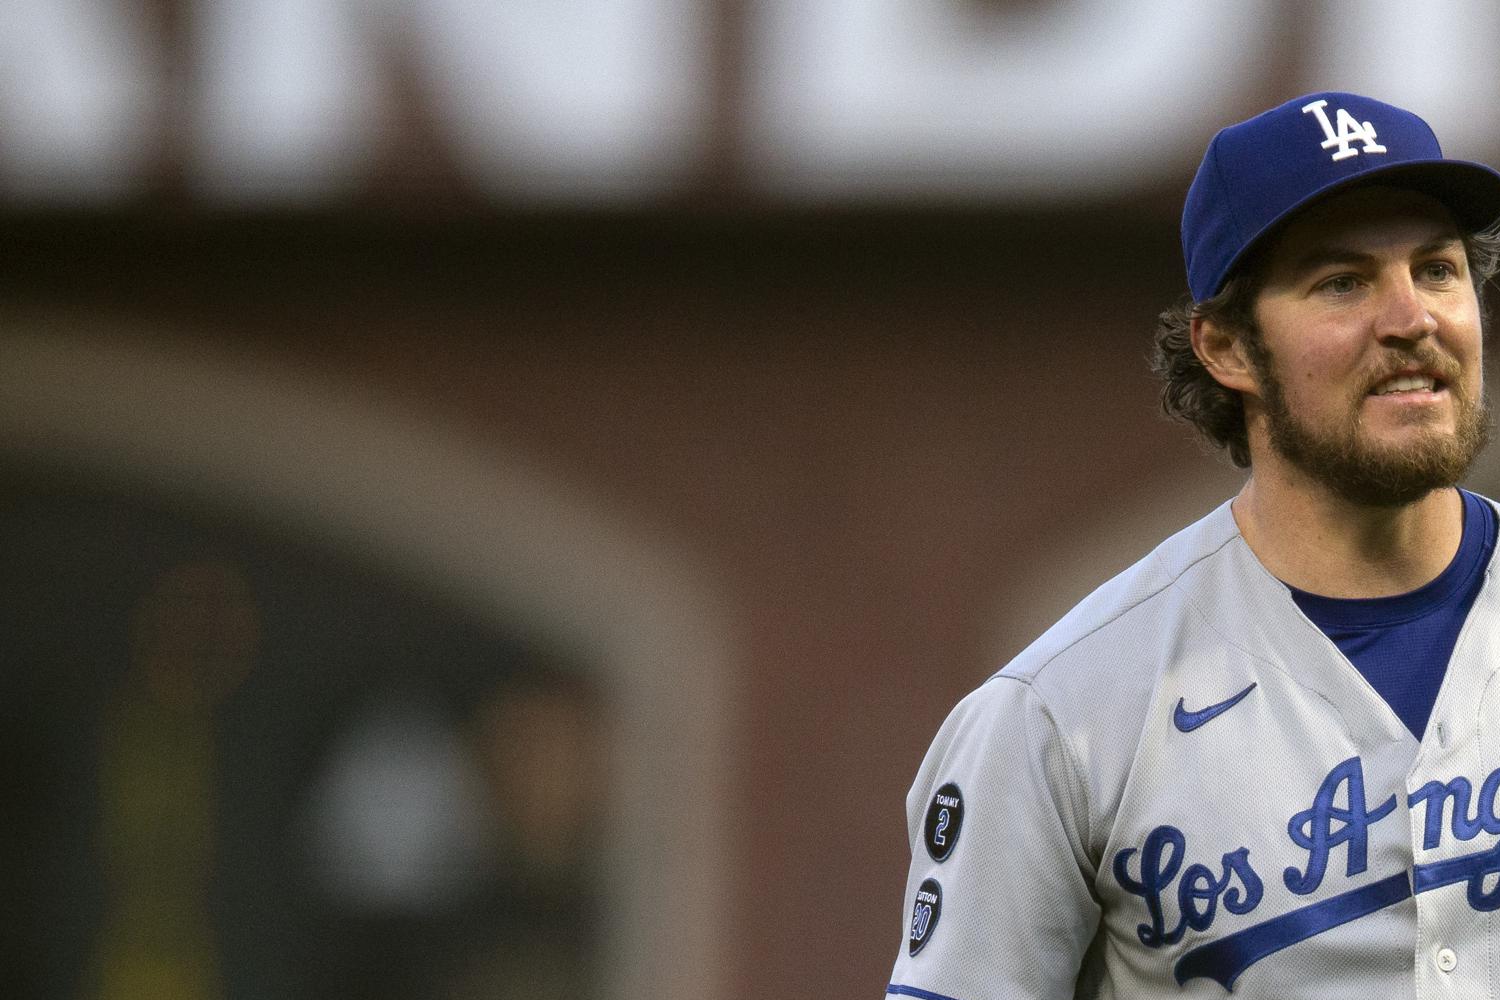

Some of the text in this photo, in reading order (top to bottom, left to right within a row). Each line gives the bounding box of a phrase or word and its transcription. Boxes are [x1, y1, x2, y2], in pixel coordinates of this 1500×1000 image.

[1301, 99, 1388, 162] LA
[936, 794, 960, 808] TOMMY
[933, 808, 950, 846] 2
[1112, 824, 1264, 948] Los
